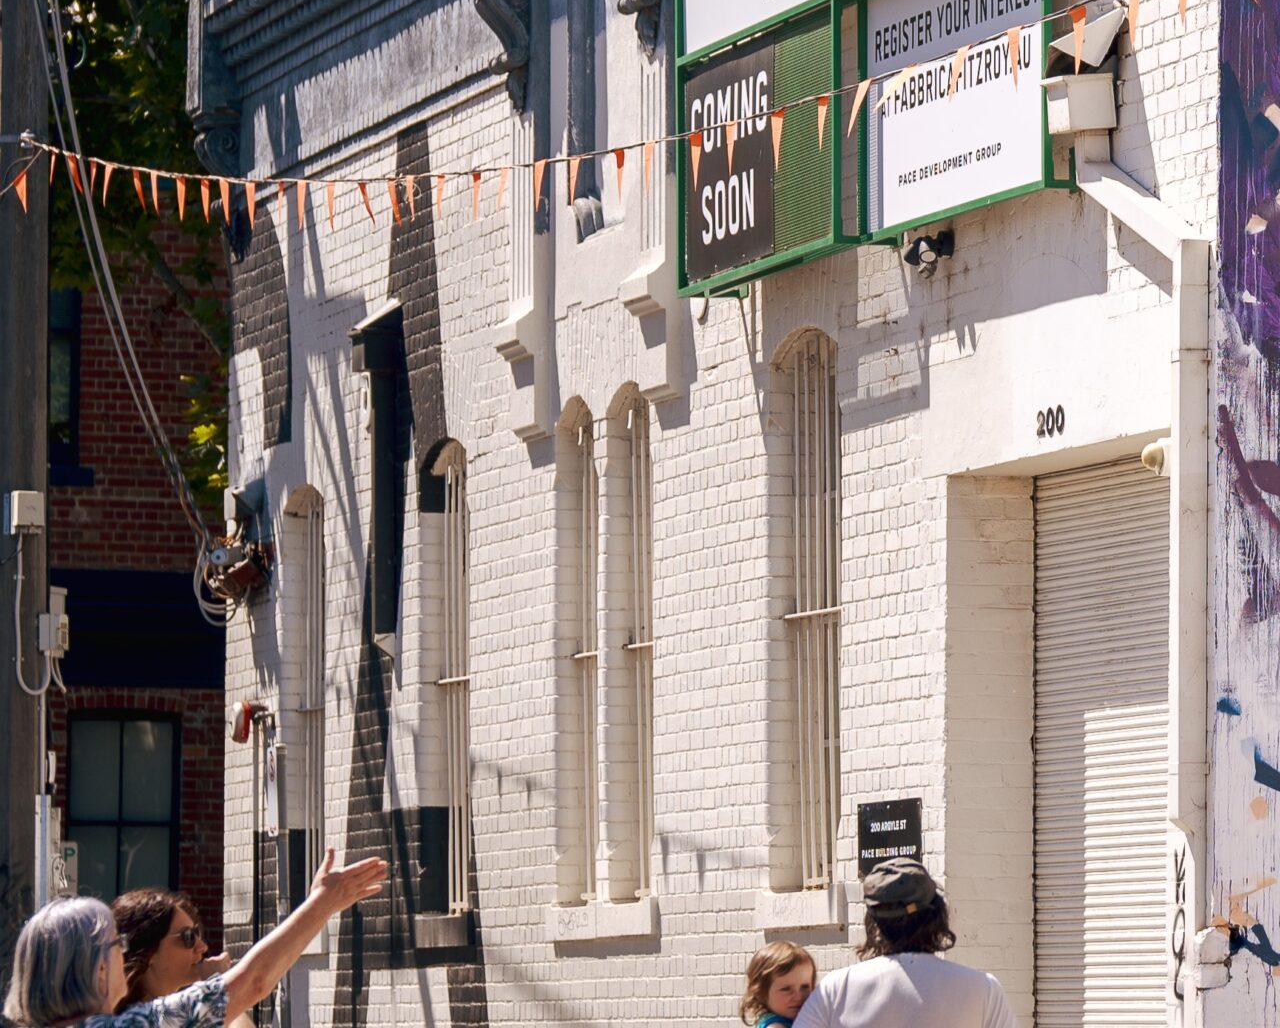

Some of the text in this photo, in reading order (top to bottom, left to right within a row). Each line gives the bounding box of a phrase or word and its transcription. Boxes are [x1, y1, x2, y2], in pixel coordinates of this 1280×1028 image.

[875, 10, 932, 63] REGISTER
[691, 70, 768, 153] COMING
[880, 94, 891, 120] AT
[898, 142, 1002, 187] PACE DEVELOPMENT GROUP
[702, 168, 755, 245] SOON
[1036, 404, 1065, 439] 200
[870, 822, 880, 832] 200
[900, 819, 907, 830] ST
[861, 849, 874, 859] PACE
[899, 844, 916, 856] GROUP
